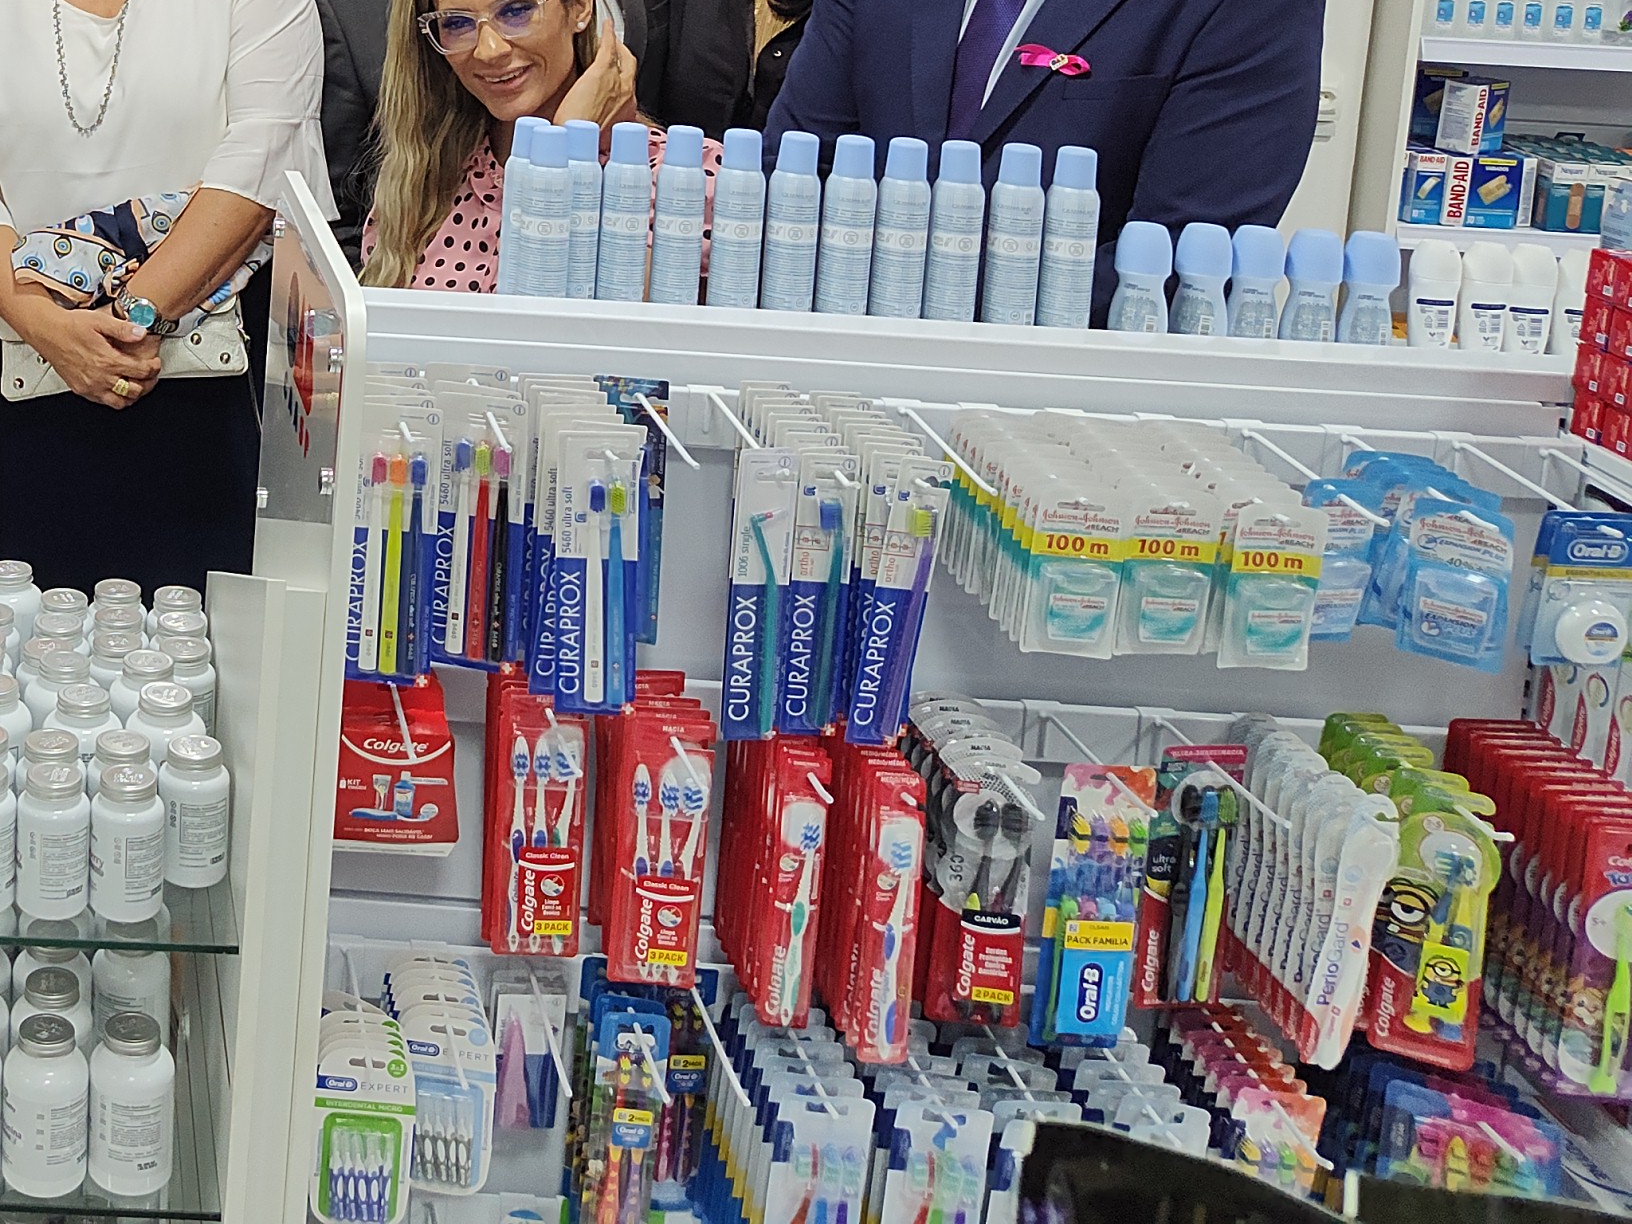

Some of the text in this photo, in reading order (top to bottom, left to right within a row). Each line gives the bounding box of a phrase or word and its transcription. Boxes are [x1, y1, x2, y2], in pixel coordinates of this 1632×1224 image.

[440, 462, 451, 505] 5460 ultra
[561, 485, 574, 553] 5460 ultra soft
[737, 526, 752, 577] 1006 single
[1046, 534, 1109, 554] 100 m
[1138, 539, 1199, 557] 100 m
[1573, 544, 1622, 559] Oral-B
[799, 551, 810, 577] ortho
[885, 557, 896, 583] ortho
[1241, 551, 1303, 569] 100 m
[558, 571, 581, 694] CURAPROX
[728, 596, 757, 721] CURAPROX
[785, 594, 816, 716] CURAPROX
[854, 600, 896, 725] CURAPROX
[525, 852, 570, 861] Classic Clean
[1151, 863, 1172, 874] soft
[1152, 855, 1177, 864] ultra
[644, 880, 690, 892] Classic Clean
[521, 869, 538, 931] Colgate
[536, 922, 569, 931] 3 PACK
[634, 898, 654, 962] Colgate
[974, 914, 1009, 926] CARVÃO
[1067, 934, 1092, 944] PACK
[649, 952, 684, 962] 3 PACK
[956, 932, 976, 997] Colgate
[1141, 930, 1160, 993] Colgate
[1316, 918, 1349, 1006] PerioGard
[974, 989, 1012, 1002] 2 PACK
[1079, 966, 1100, 1021] Oral-B
[1375, 976, 1397, 1038] Colgate
[361, 1079, 408, 1093] EXPERT
[326, 1100, 403, 1113] INTERDENTAL MICRO
